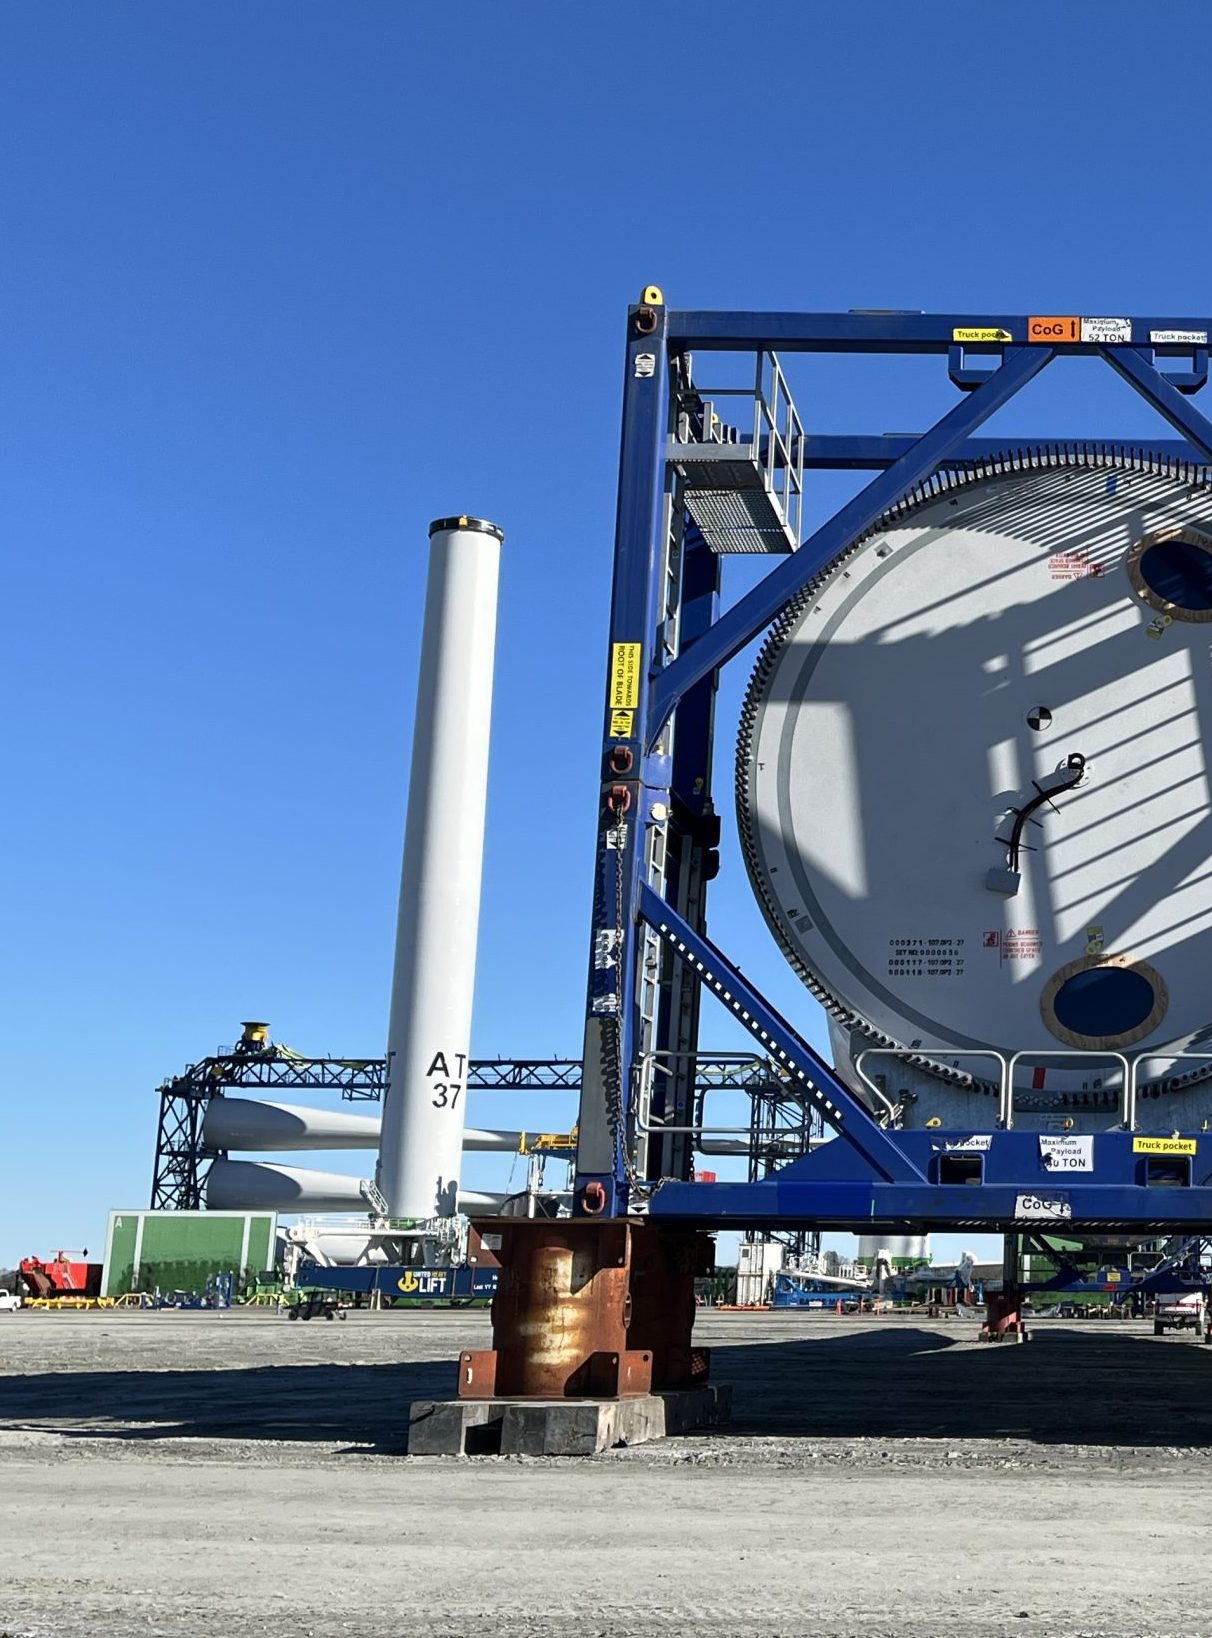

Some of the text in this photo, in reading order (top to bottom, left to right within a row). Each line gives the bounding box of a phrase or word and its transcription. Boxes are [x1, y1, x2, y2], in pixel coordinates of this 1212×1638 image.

[1032, 323, 1064, 335] CoG
[1088, 334, 1125, 342] 52 TON
[615, 645, 626, 706] ROOT OF BLADE
[625, 675, 633, 706] TOWARDS
[432, 1082, 461, 1109] 37
[1051, 1147, 1081, 1156] Payload
[1137, 1140, 1192, 1151] Truck pocket
[1063, 1158, 1086, 1168] TON
[419, 1278, 446, 1292] LIFT
